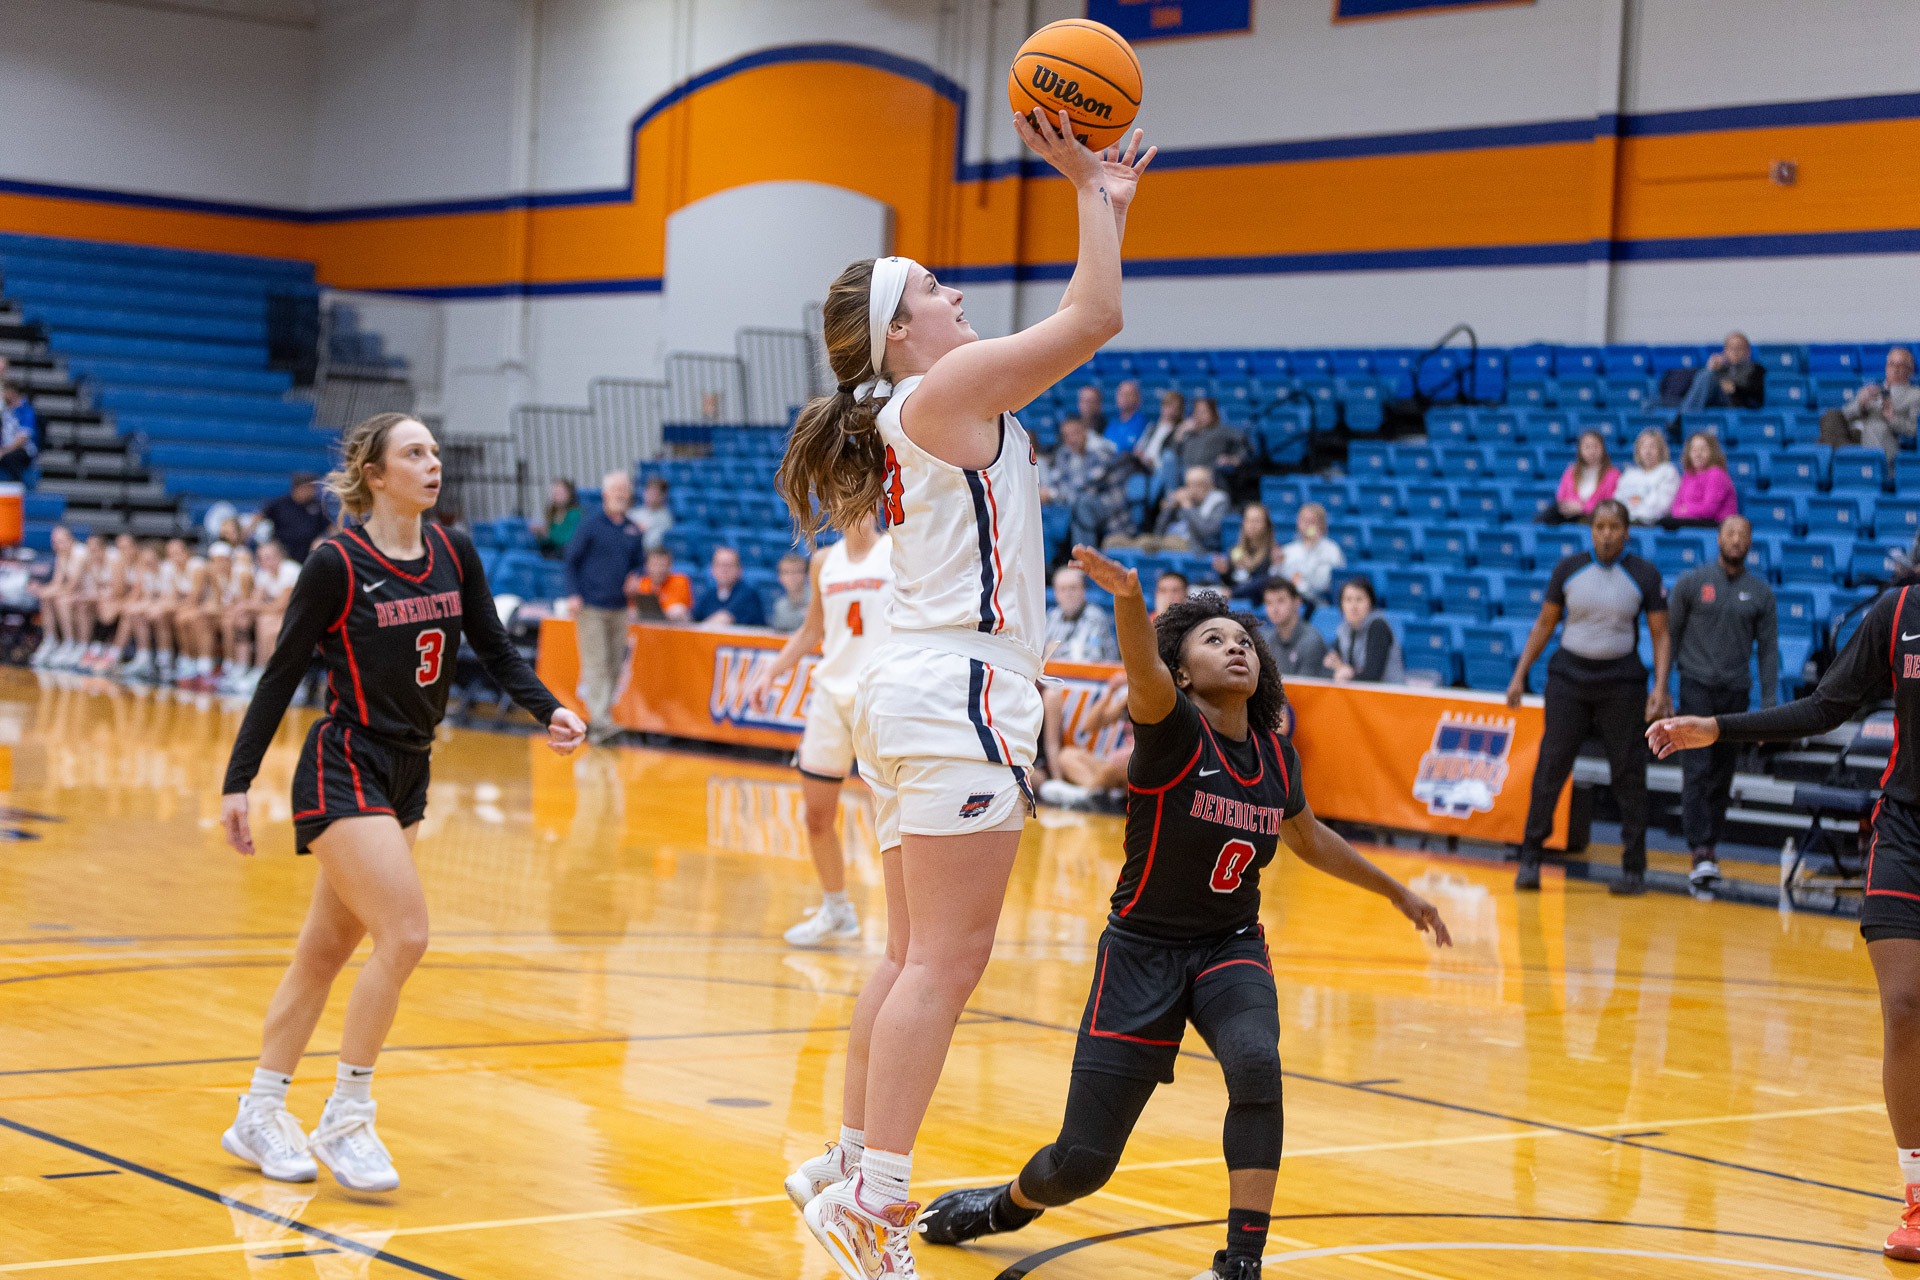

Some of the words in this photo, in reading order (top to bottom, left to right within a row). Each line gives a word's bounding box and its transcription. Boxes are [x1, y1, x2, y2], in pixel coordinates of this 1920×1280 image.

[1032, 64, 1112, 120] Wilson
[415, 628, 446, 687] 3
[1209, 838, 1256, 893] 0
